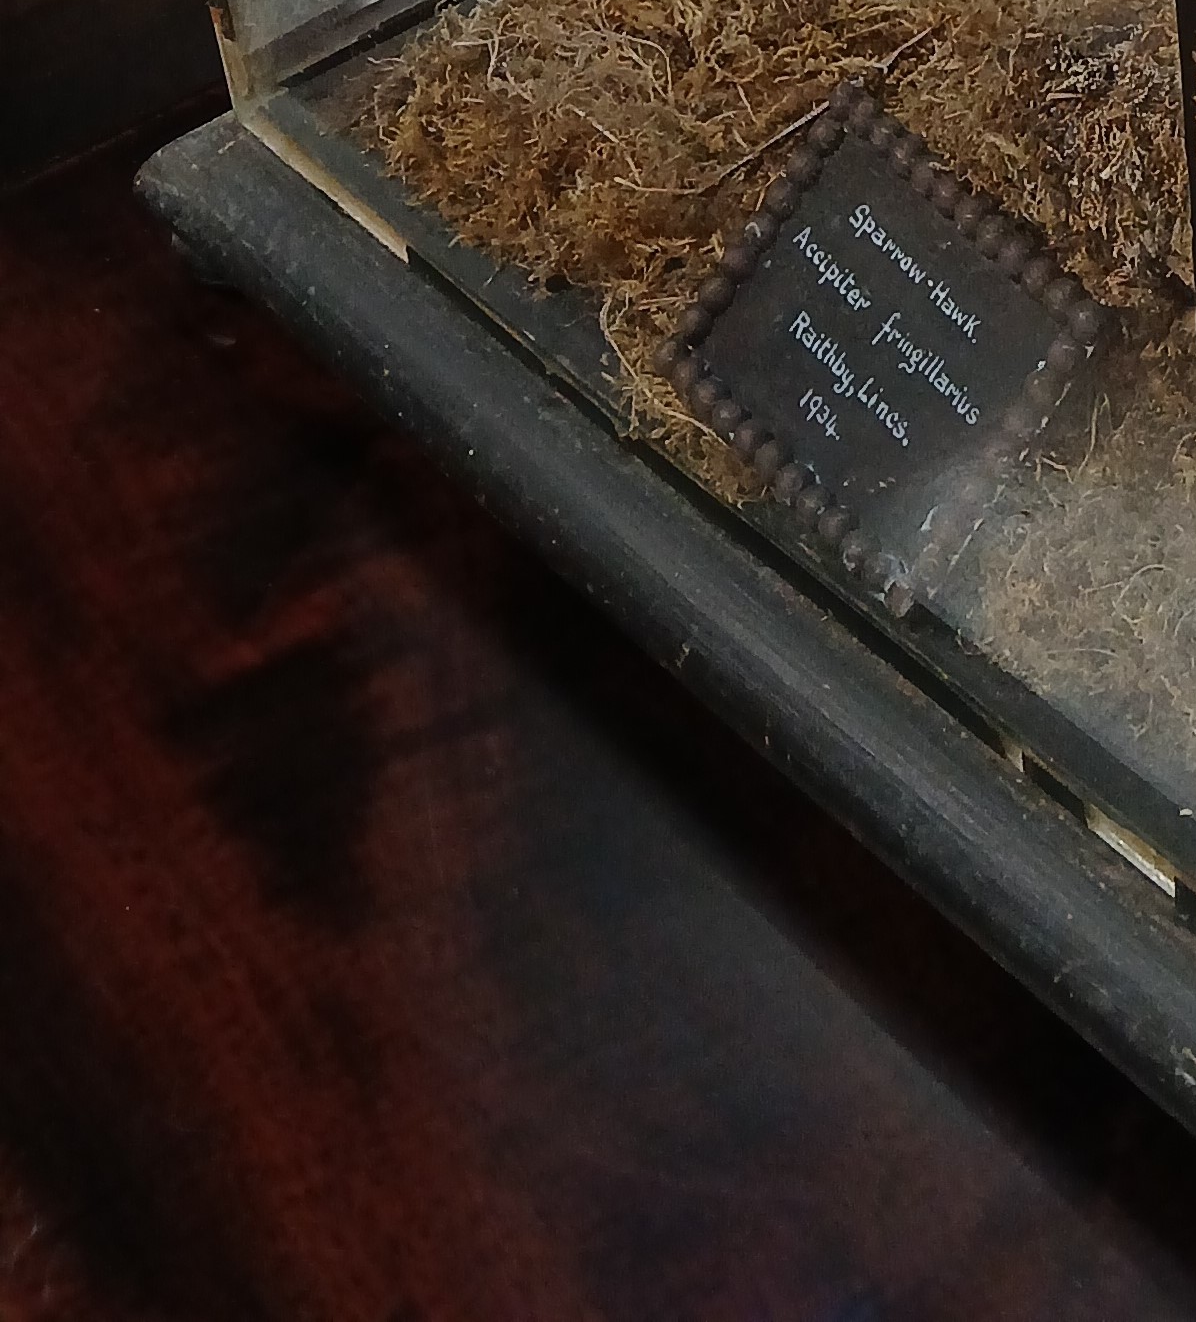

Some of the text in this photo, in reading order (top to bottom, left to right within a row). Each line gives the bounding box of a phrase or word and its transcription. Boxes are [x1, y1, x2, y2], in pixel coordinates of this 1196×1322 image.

[789, 310, 909, 447] Raithby, Lincs.
[792, 226, 980, 425] Accipiter fringillarius
[799, 387, 841, 441] 1934.
